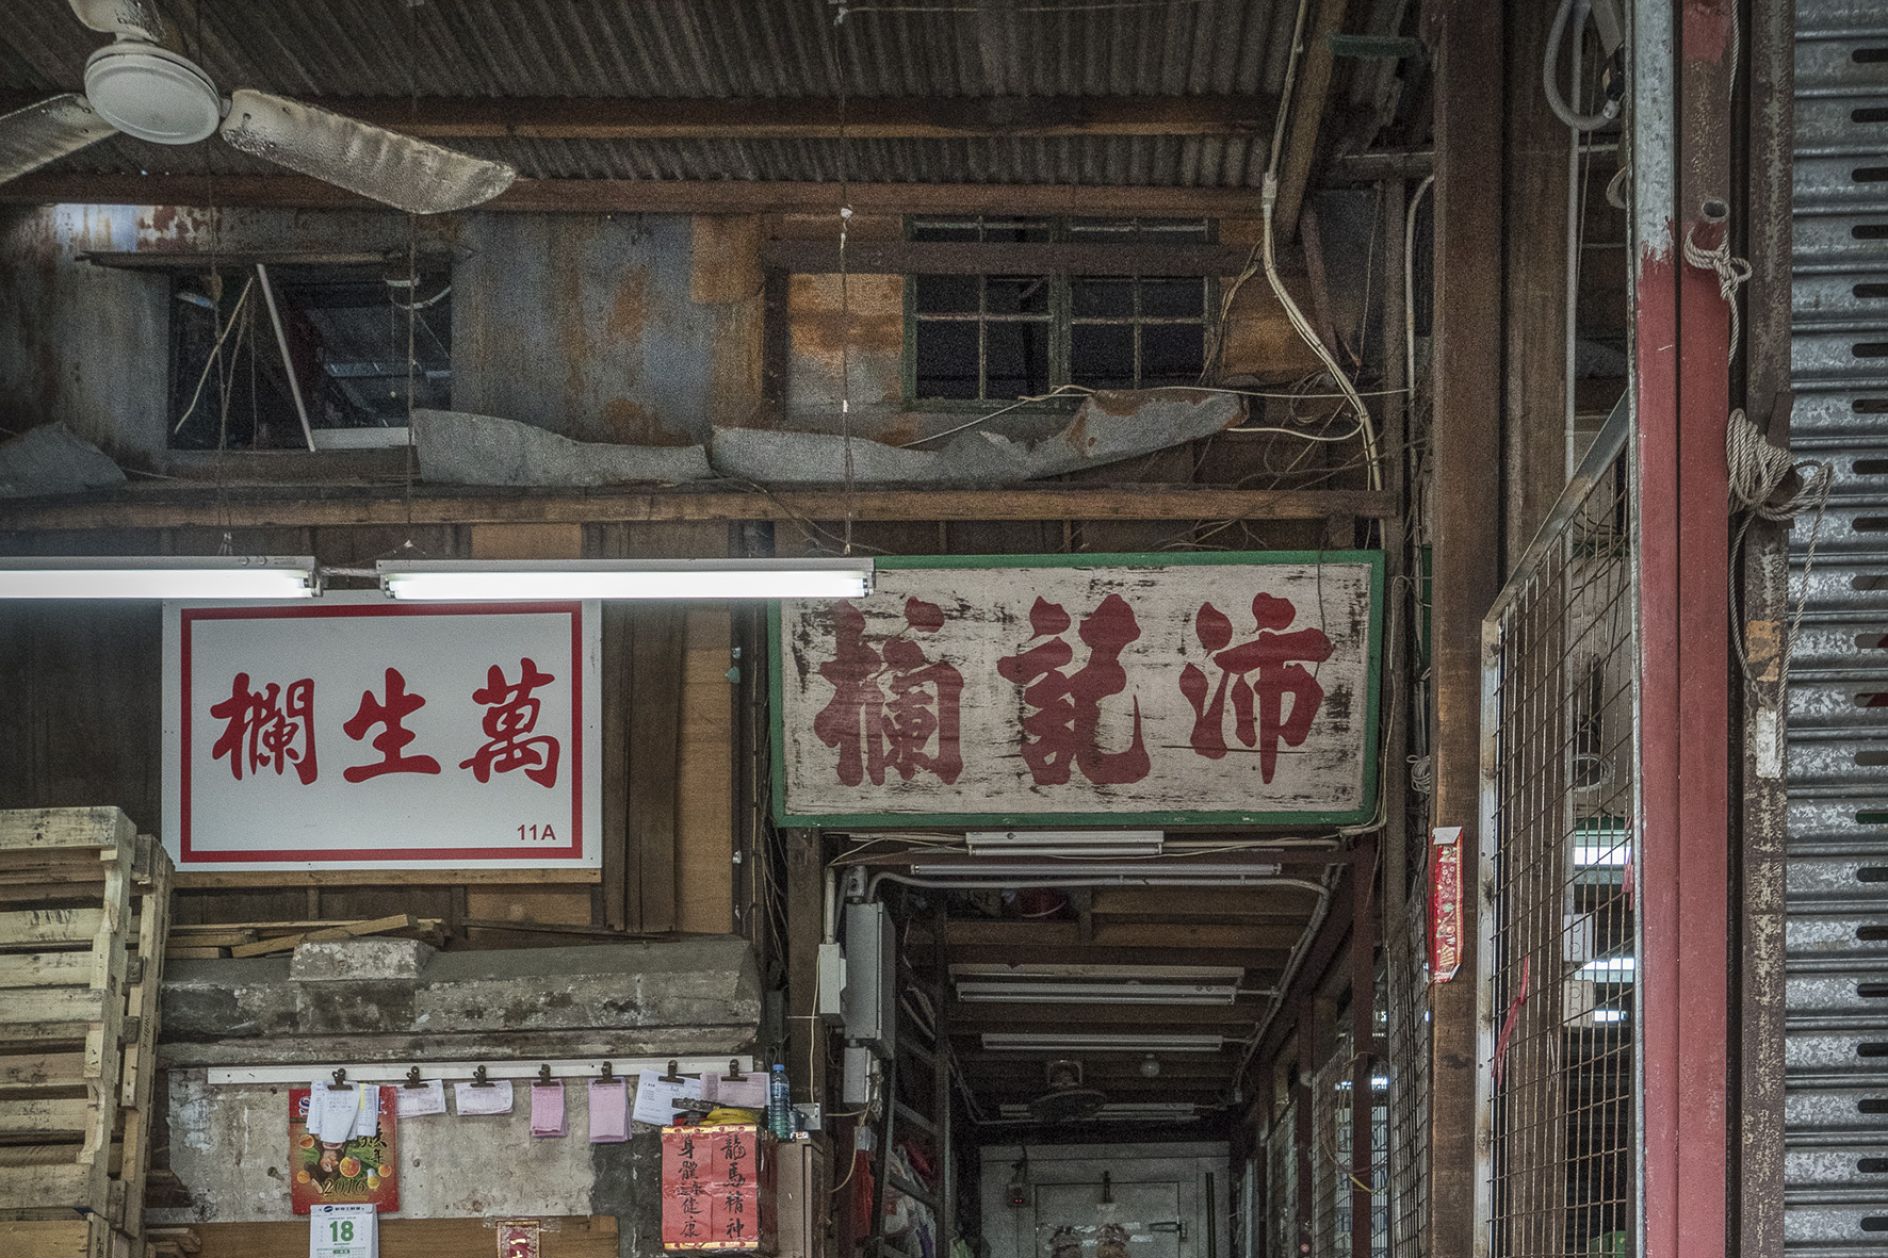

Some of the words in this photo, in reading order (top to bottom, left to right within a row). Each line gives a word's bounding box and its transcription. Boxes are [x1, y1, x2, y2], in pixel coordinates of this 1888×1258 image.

[516, 823, 556, 841] 11A
[323, 1177, 367, 1196] 2016
[720, 1135, 747, 1239] 龍馬精神
[329, 1220, 354, 1243] 18
